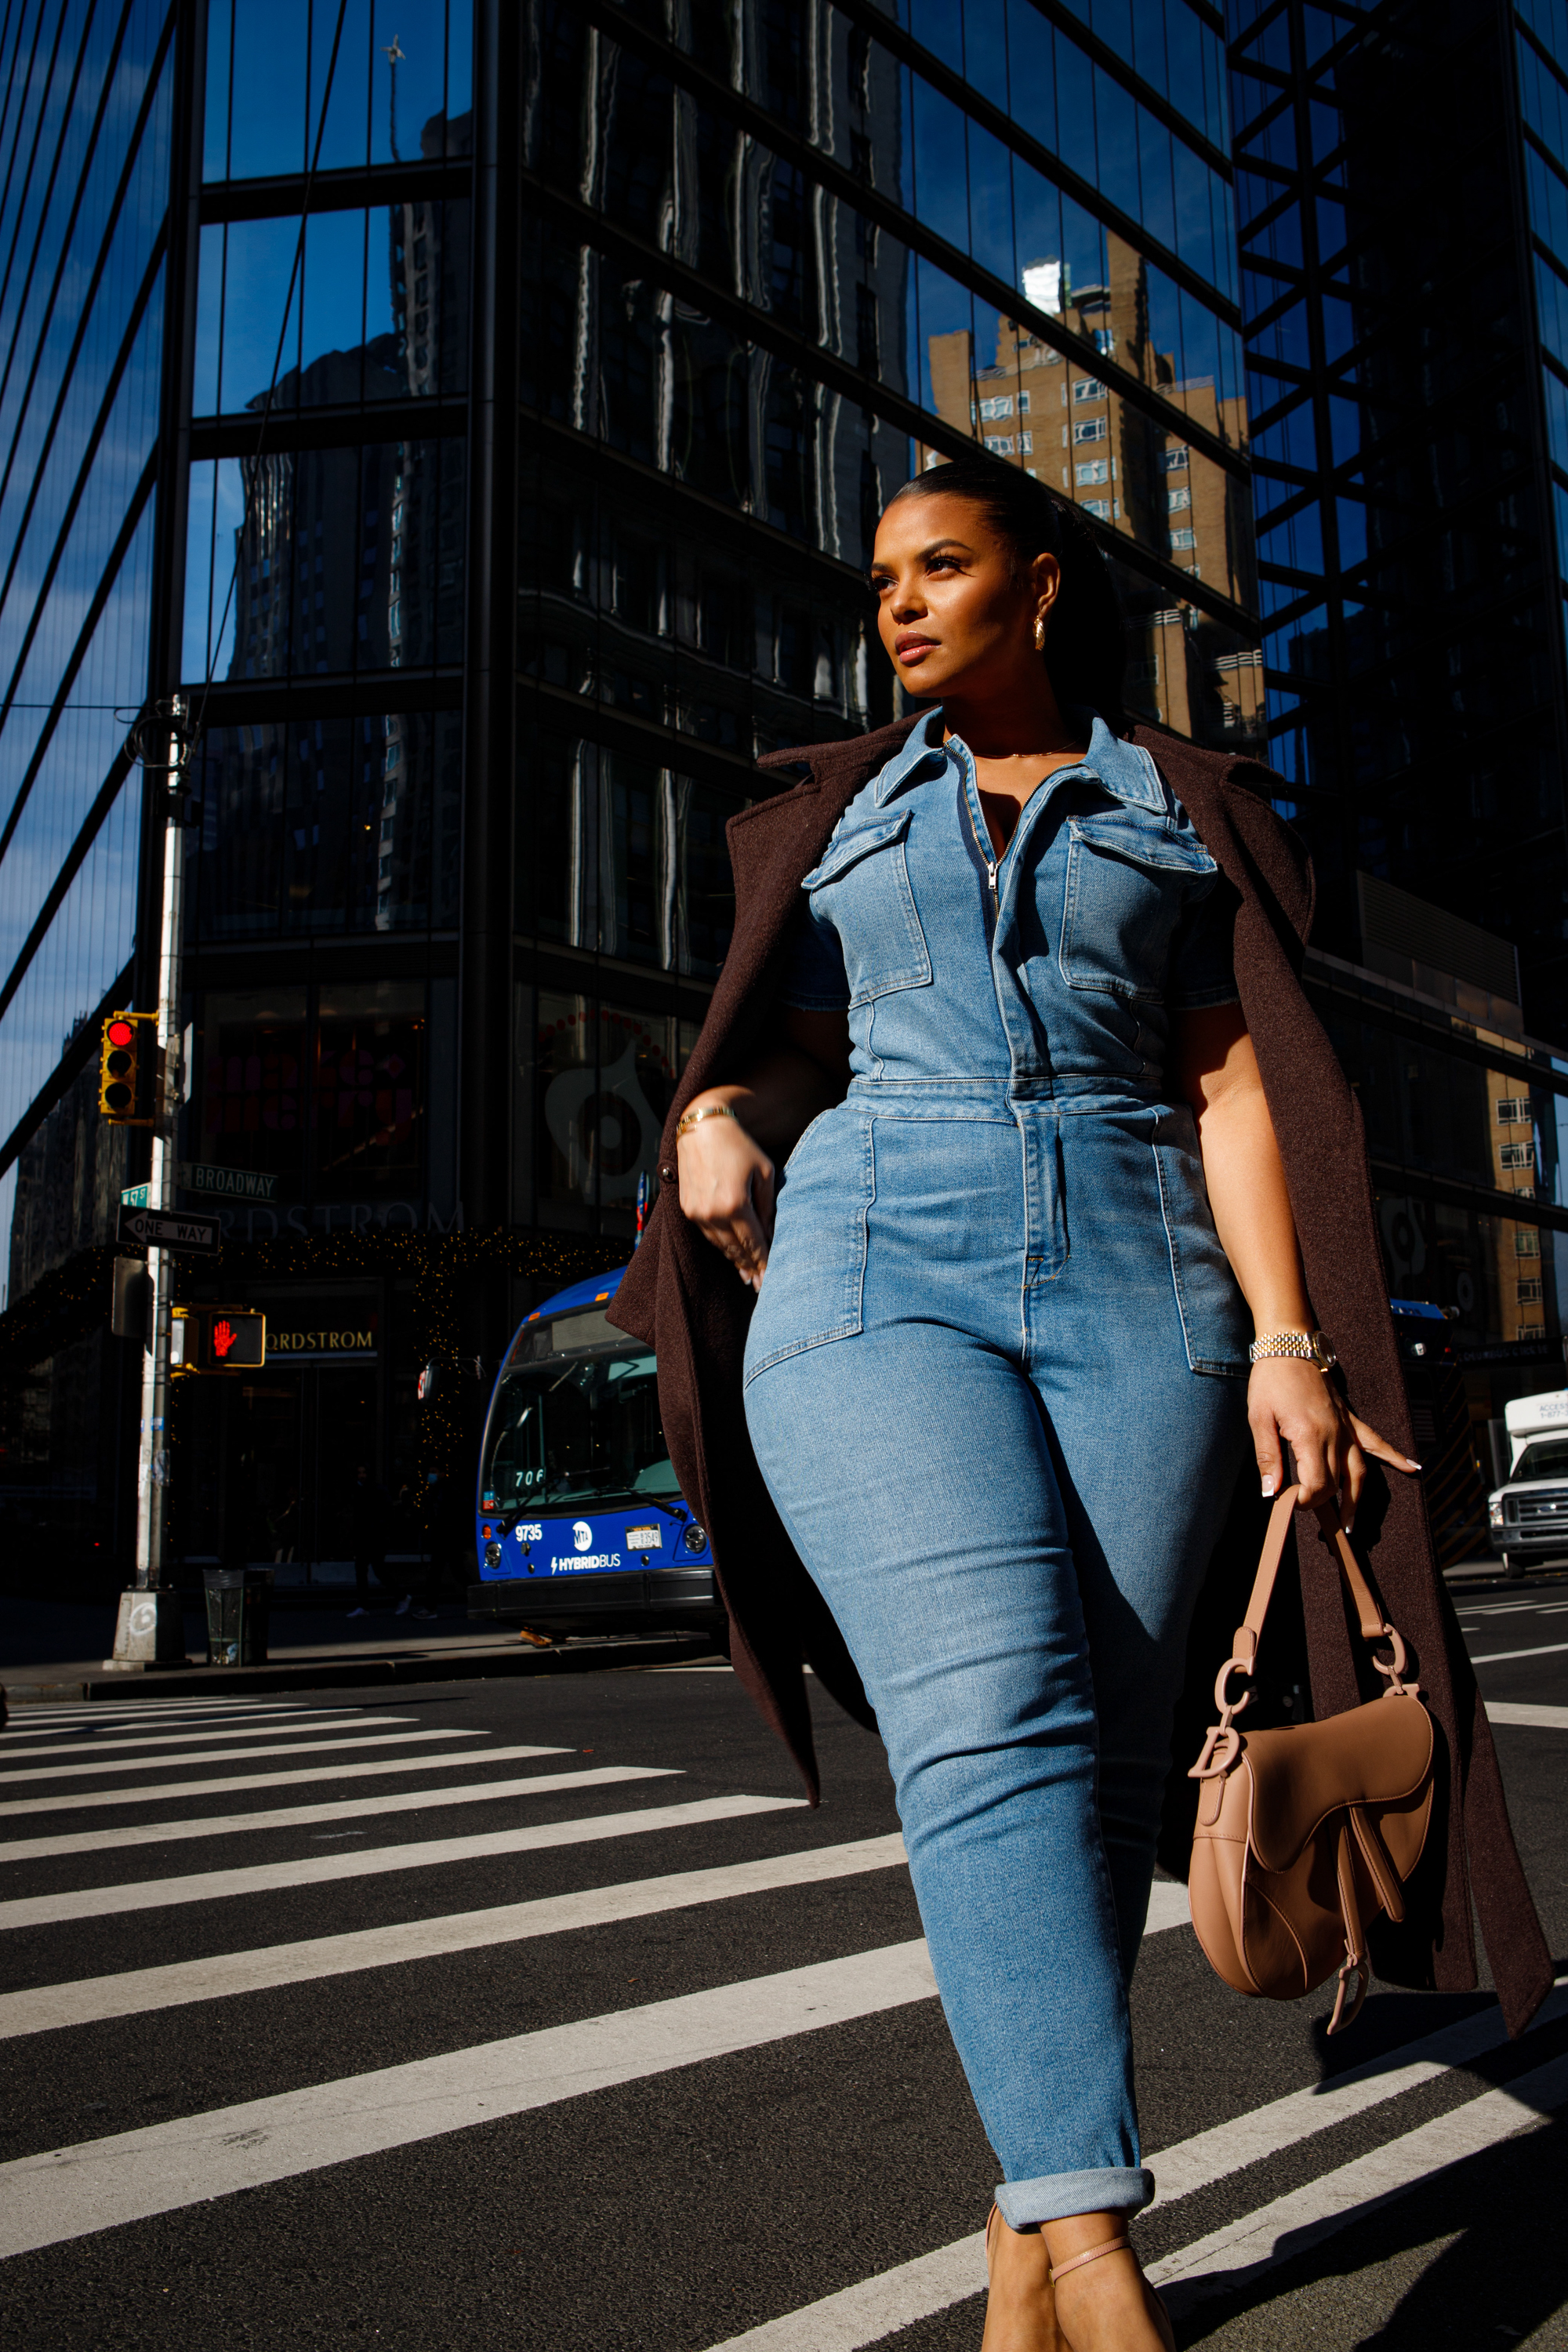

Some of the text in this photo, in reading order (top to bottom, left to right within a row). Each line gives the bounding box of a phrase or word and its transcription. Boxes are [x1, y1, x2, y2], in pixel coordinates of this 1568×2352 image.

[195, 1167, 274, 1198] BROADWAY
[130, 1189, 139, 1207] 57
[140, 1187, 146, 1200] ST
[135, 1219, 207, 1242] ONE WAY
[215, 1201, 464, 1244] RDSTROM
[265, 1330, 373, 1351] ORDSTROM
[515, 1523, 543, 1542] 9735
[574, 1529, 590, 1544] MTA
[558, 1553, 621, 1571] HYBRIDBUS
